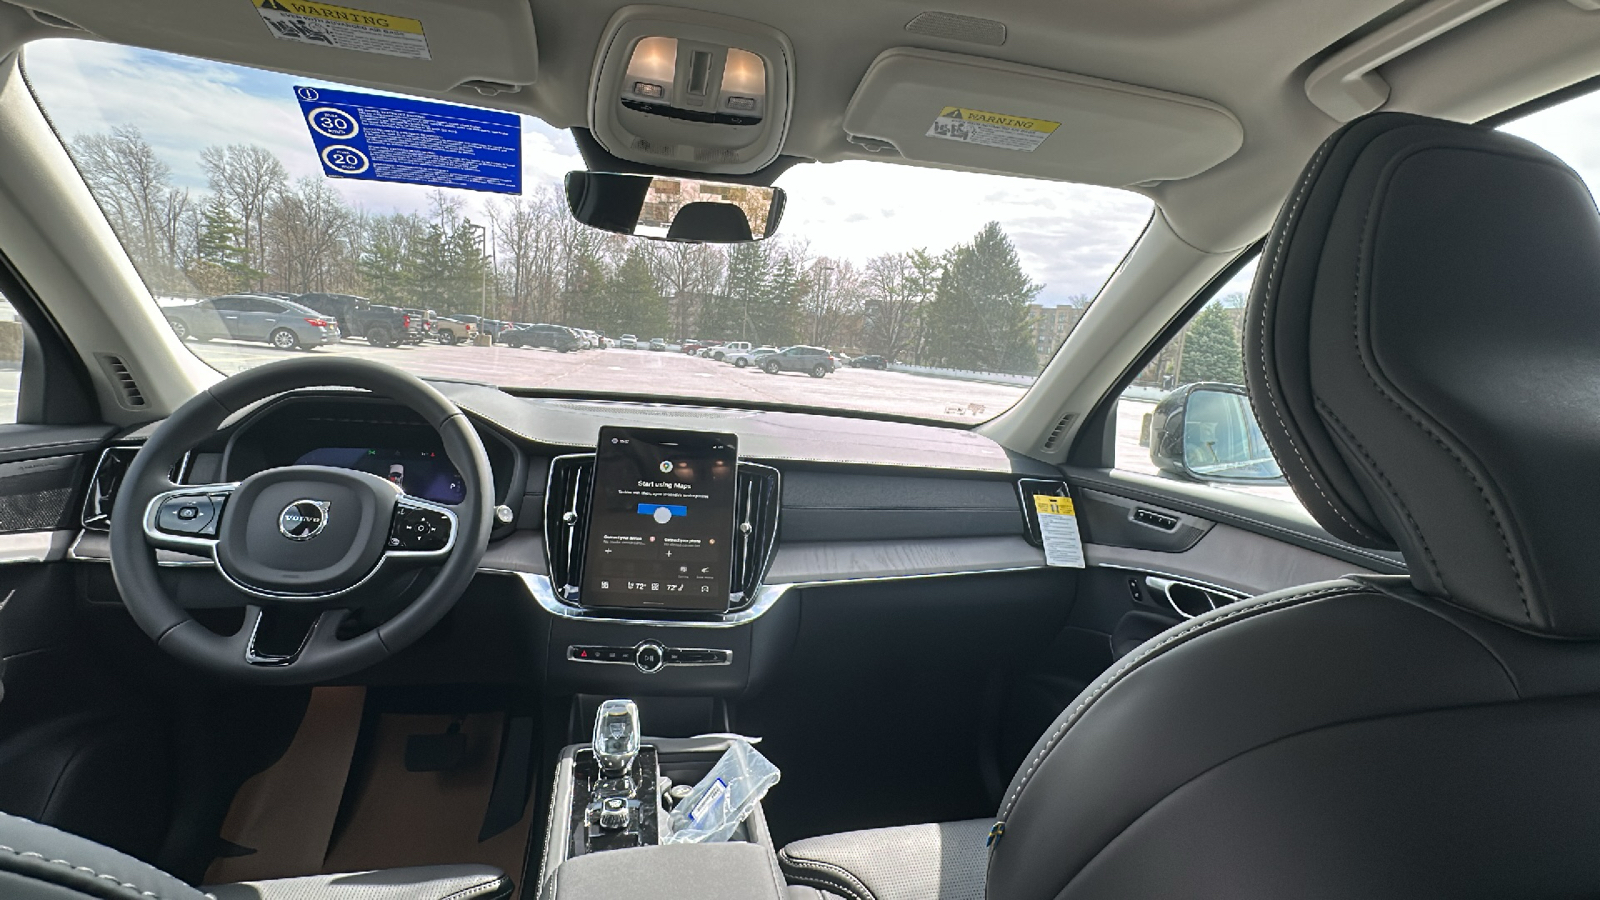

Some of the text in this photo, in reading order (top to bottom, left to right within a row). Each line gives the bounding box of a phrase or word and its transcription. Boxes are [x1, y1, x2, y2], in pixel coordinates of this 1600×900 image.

[291, 2, 391, 28] WARNING
[320, 117, 347, 129] 30
[967, 112, 1034, 129] WARNING
[333, 154, 358, 165] 20
[637, 480, 692, 490] Start using Maps
[284, 514, 321, 523] VOLVO
